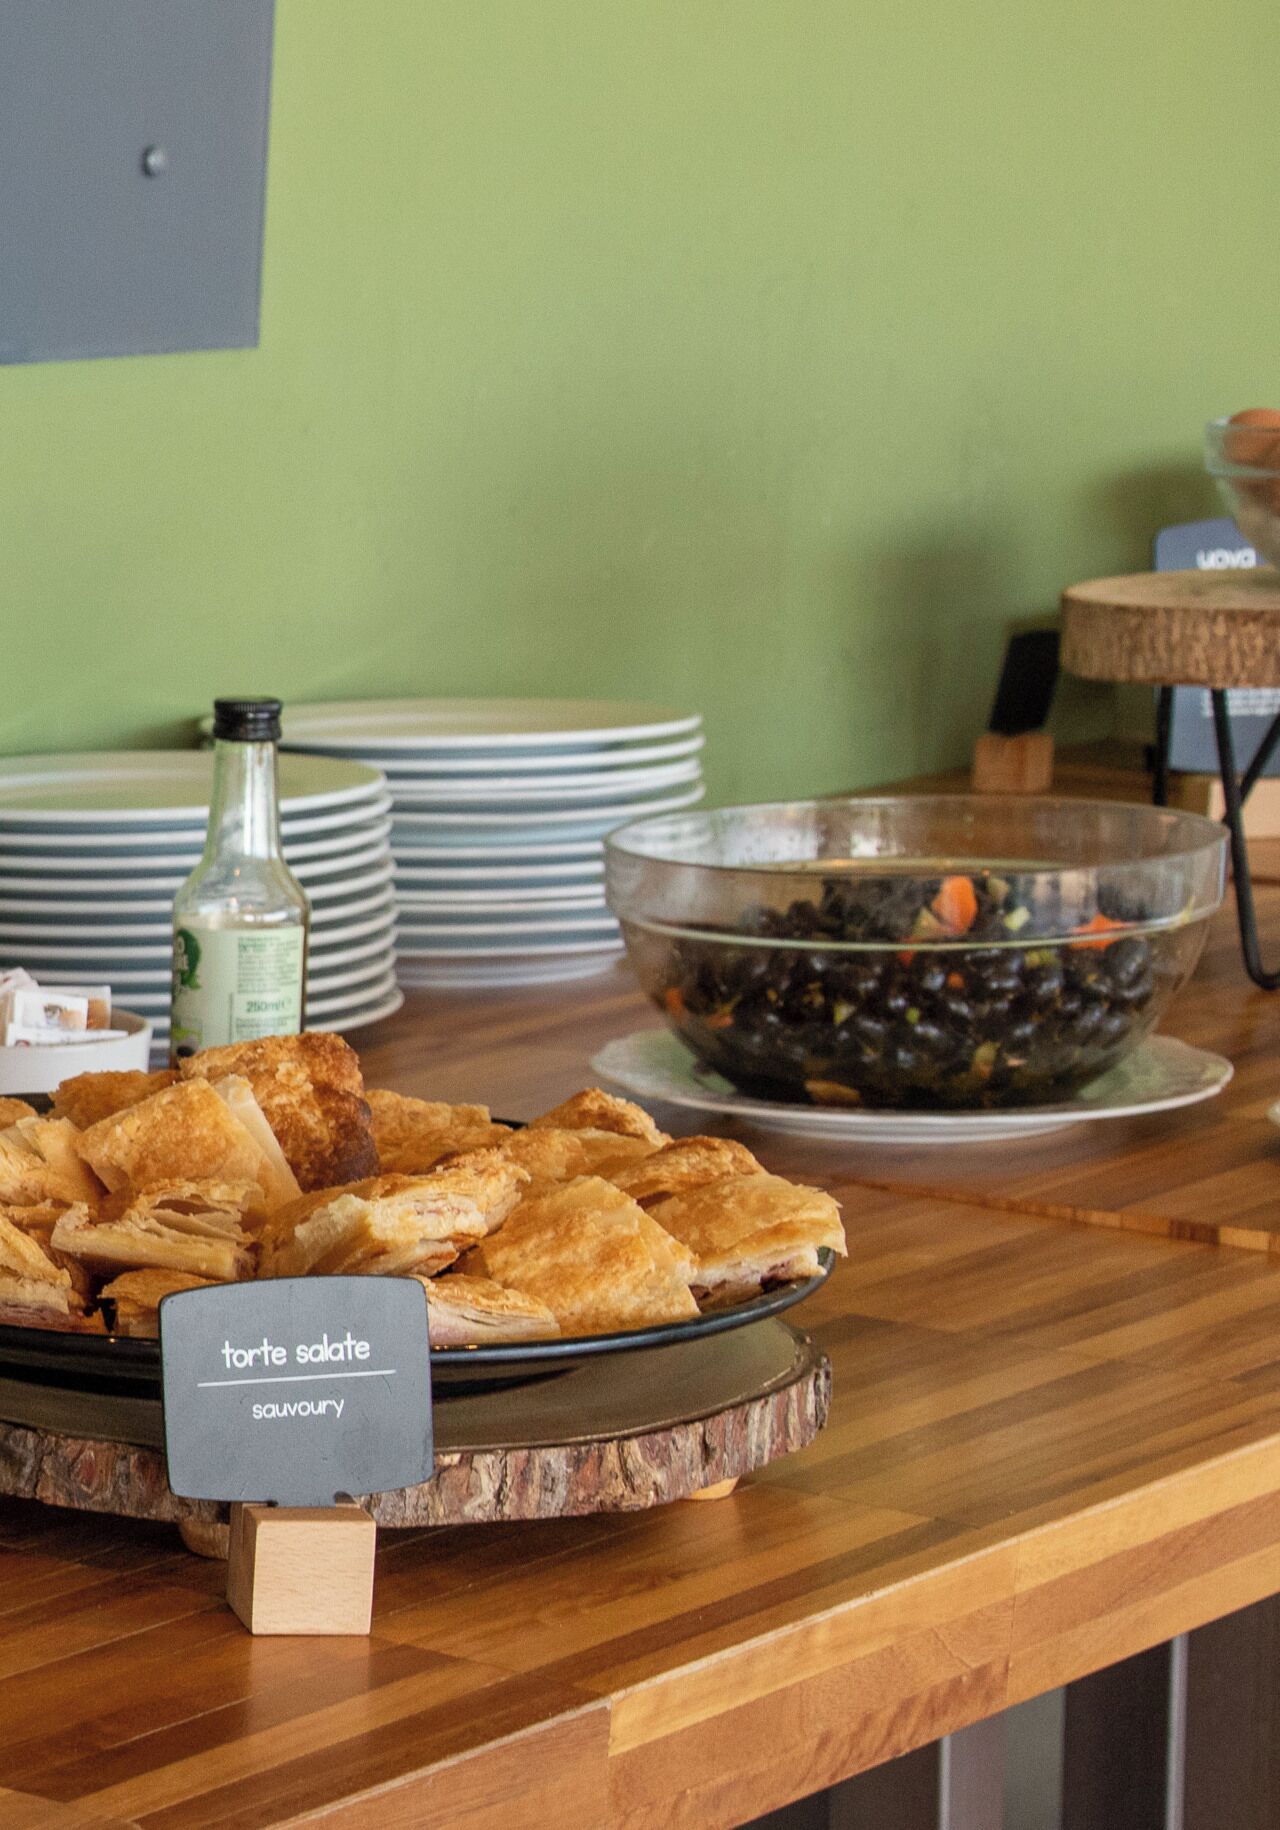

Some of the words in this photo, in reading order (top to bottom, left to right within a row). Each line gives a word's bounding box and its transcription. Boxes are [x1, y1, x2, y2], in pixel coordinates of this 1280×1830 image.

[222, 1338, 287, 1369] torte
[296, 1332, 370, 1364] salate
[252, 1399, 345, 1419] sauvoury
